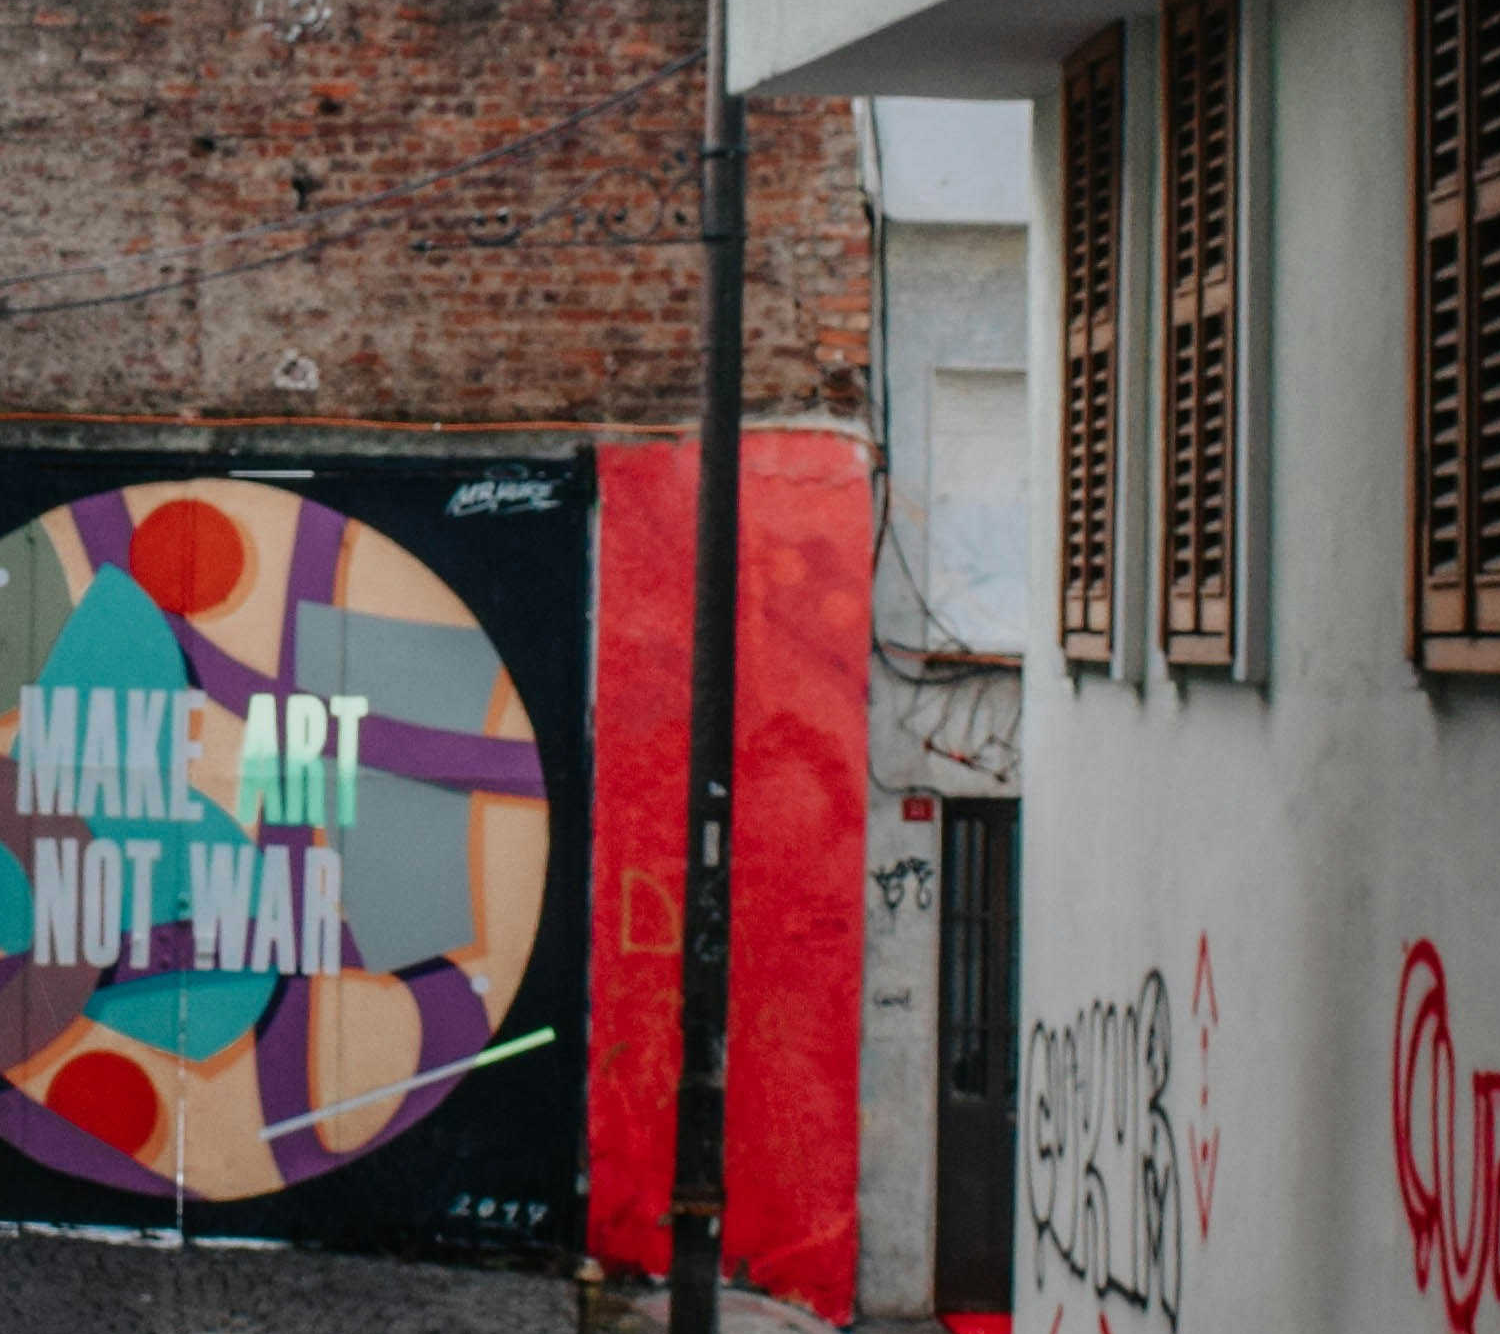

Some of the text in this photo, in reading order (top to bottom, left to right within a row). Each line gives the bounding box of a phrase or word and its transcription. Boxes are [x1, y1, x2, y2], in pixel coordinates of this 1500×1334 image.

[17, 685, 368, 827] MAKE ART
[34, 837, 342, 975] NOT WAR
